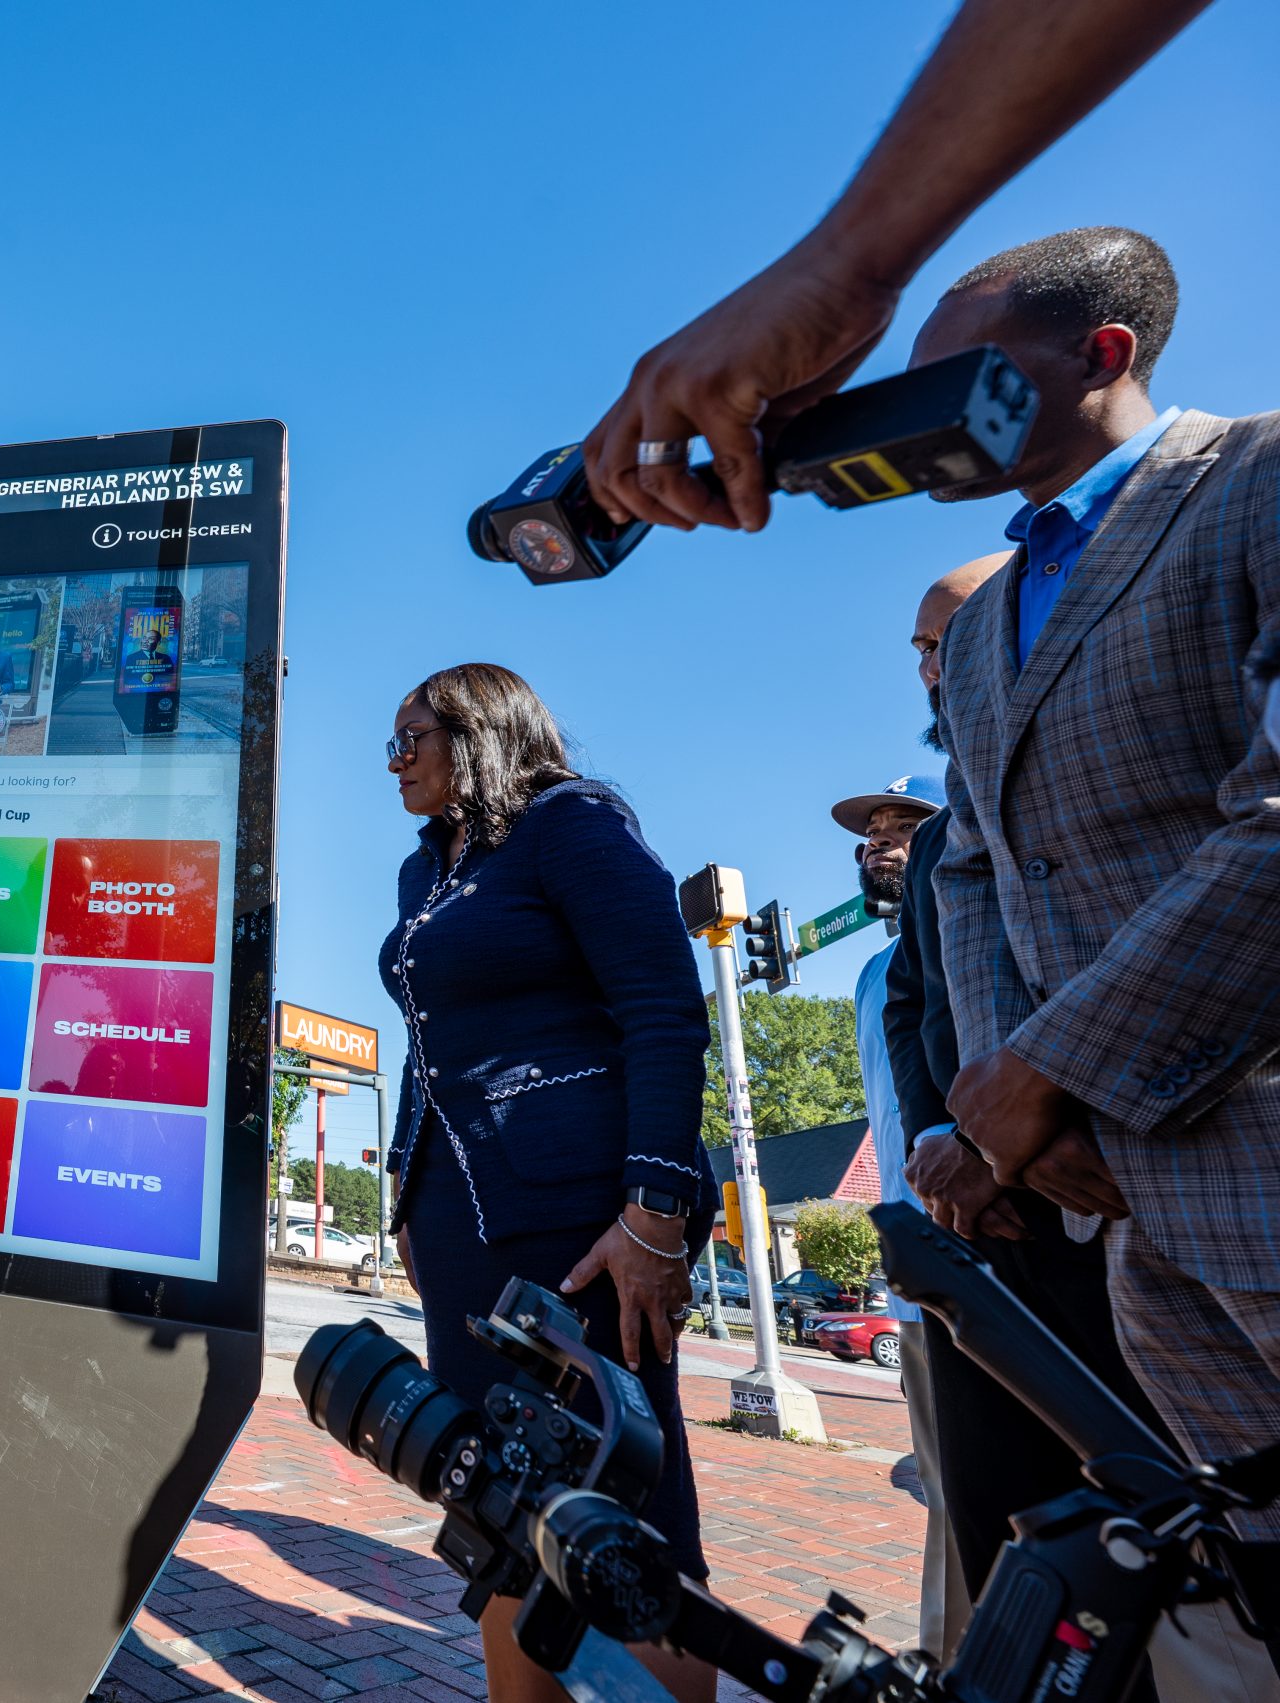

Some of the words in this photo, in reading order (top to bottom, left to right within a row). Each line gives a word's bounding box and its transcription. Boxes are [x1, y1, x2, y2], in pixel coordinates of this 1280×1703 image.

[123, 467, 184, 488] PKWY
[189, 464, 222, 481] SW
[227, 463, 243, 478] &
[61, 487, 170, 509] HEADLAND
[175, 484, 202, 500] DR
[209, 479, 244, 497] SW
[126, 527, 182, 541] TOUCH
[187, 523, 252, 537] SCREEN
[2, 630, 23, 638] hello
[8, 776, 50, 788] looking
[53, 776, 76, 786] for?
[5, 809, 31, 823] Cup
[89, 881, 176, 897] PHOTO
[87, 900, 175, 916] BOOTH
[809, 907, 859, 944] Greenbriar
[53, 1020, 191, 1044] SCHEDULE
[283, 1013, 375, 1060] LAUNDRY
[57, 1165, 162, 1193] EVENTS
[732, 1391, 748, 1403] WE
[748, 1393, 774, 1407] TOW
